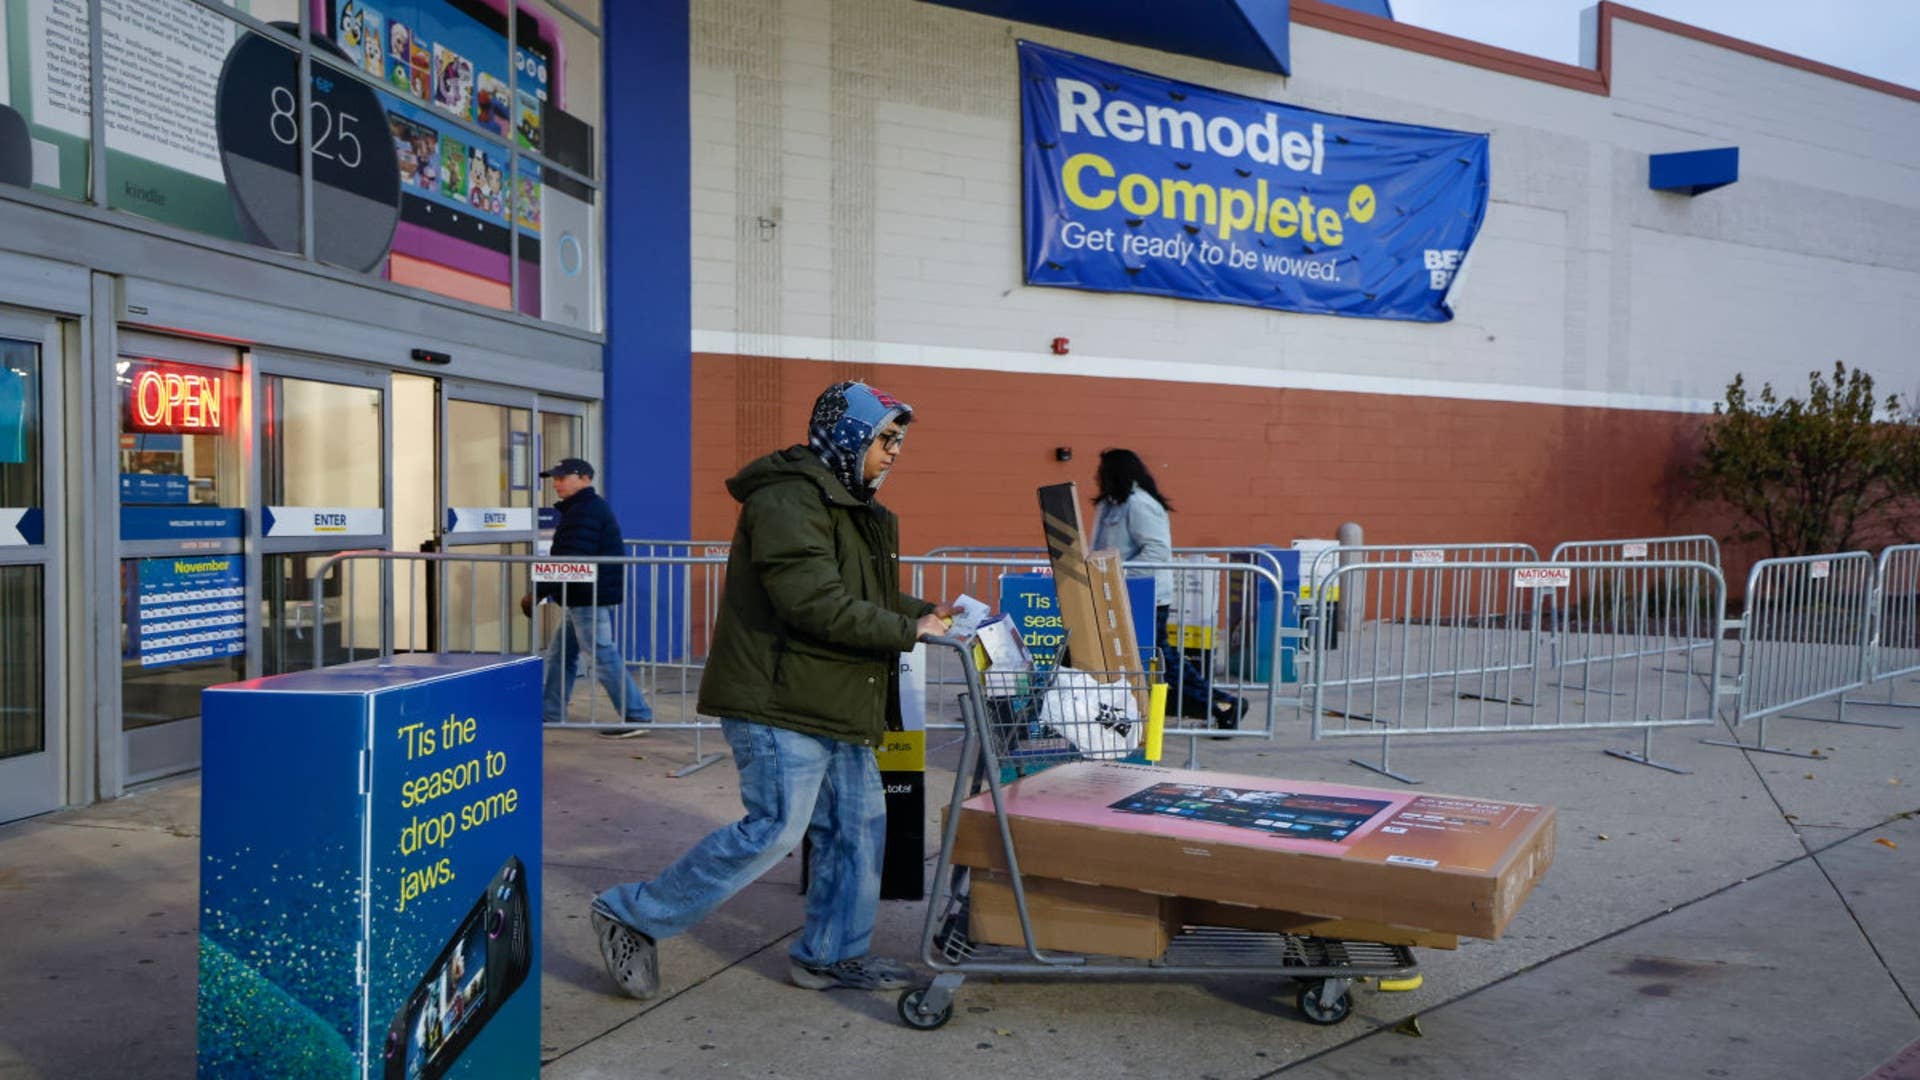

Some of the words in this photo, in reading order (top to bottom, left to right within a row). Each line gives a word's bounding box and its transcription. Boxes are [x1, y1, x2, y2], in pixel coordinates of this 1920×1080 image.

[1056, 78, 1325, 175] Remodel
[1061, 153, 1344, 245] Complete
[1061, 222, 1114, 251] Get
[1122, 234, 1193, 267] ready
[1200, 240, 1224, 265] to
[1229, 241, 1258, 270] be
[1263, 251, 1340, 282] wowed.
[1430, 270, 1453, 290] B
[138, 371, 220, 427] OPEN
[314, 513, 346, 526] ENTER
[484, 513, 506, 523] ENTER
[174, 560, 230, 573] November
[535, 563, 593, 574] NATIONAL
[1517, 569, 1568, 579] NATIONAL
[1024, 615, 1063, 628] seas
[442, 714, 476, 748] the
[887, 742, 911, 752] plus
[401, 759, 480, 809] season
[486, 750, 506, 780] to
[888, 784, 911, 794] total
[400, 809, 455, 857] drop
[461, 788, 518, 832] some
[397, 857, 456, 912] jaws.
